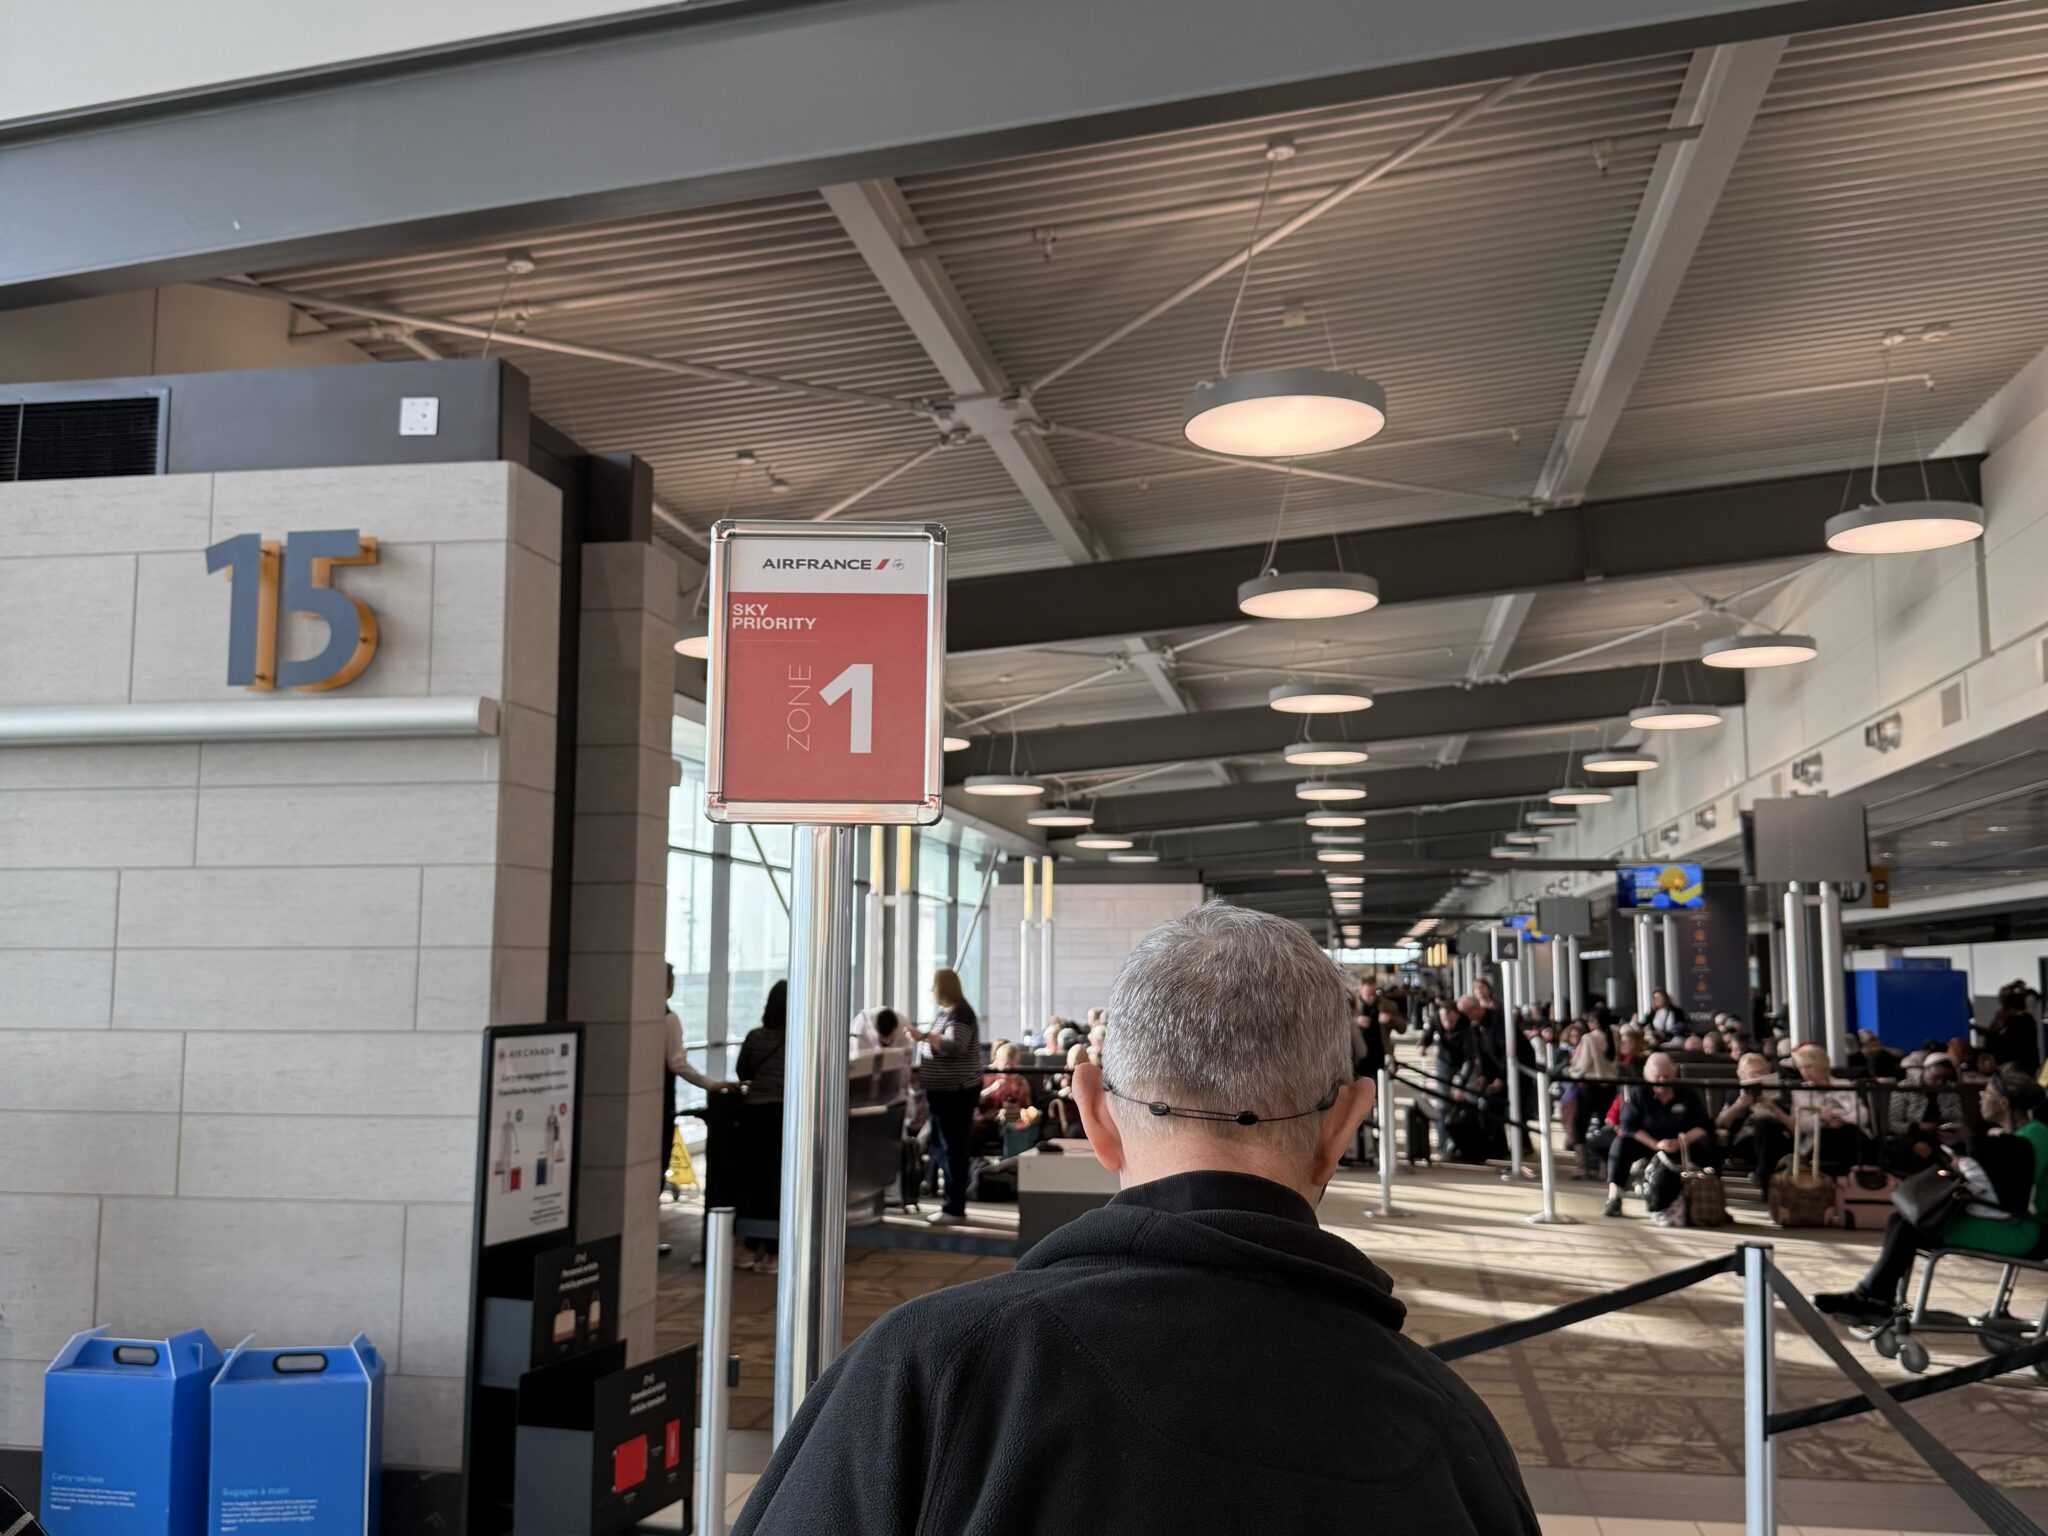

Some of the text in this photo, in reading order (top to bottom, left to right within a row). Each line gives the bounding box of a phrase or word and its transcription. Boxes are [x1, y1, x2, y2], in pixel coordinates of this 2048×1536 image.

[762, 558, 872, 571] AIRFRANCE
[205, 529, 376, 691] 15
[732, 603, 769, 616] SKY
[732, 617, 817, 630] PRIORITY
[786, 664, 812, 752] ZONE
[818, 663, 873, 754] 1
[523, 1046, 555, 1057] CANADA
